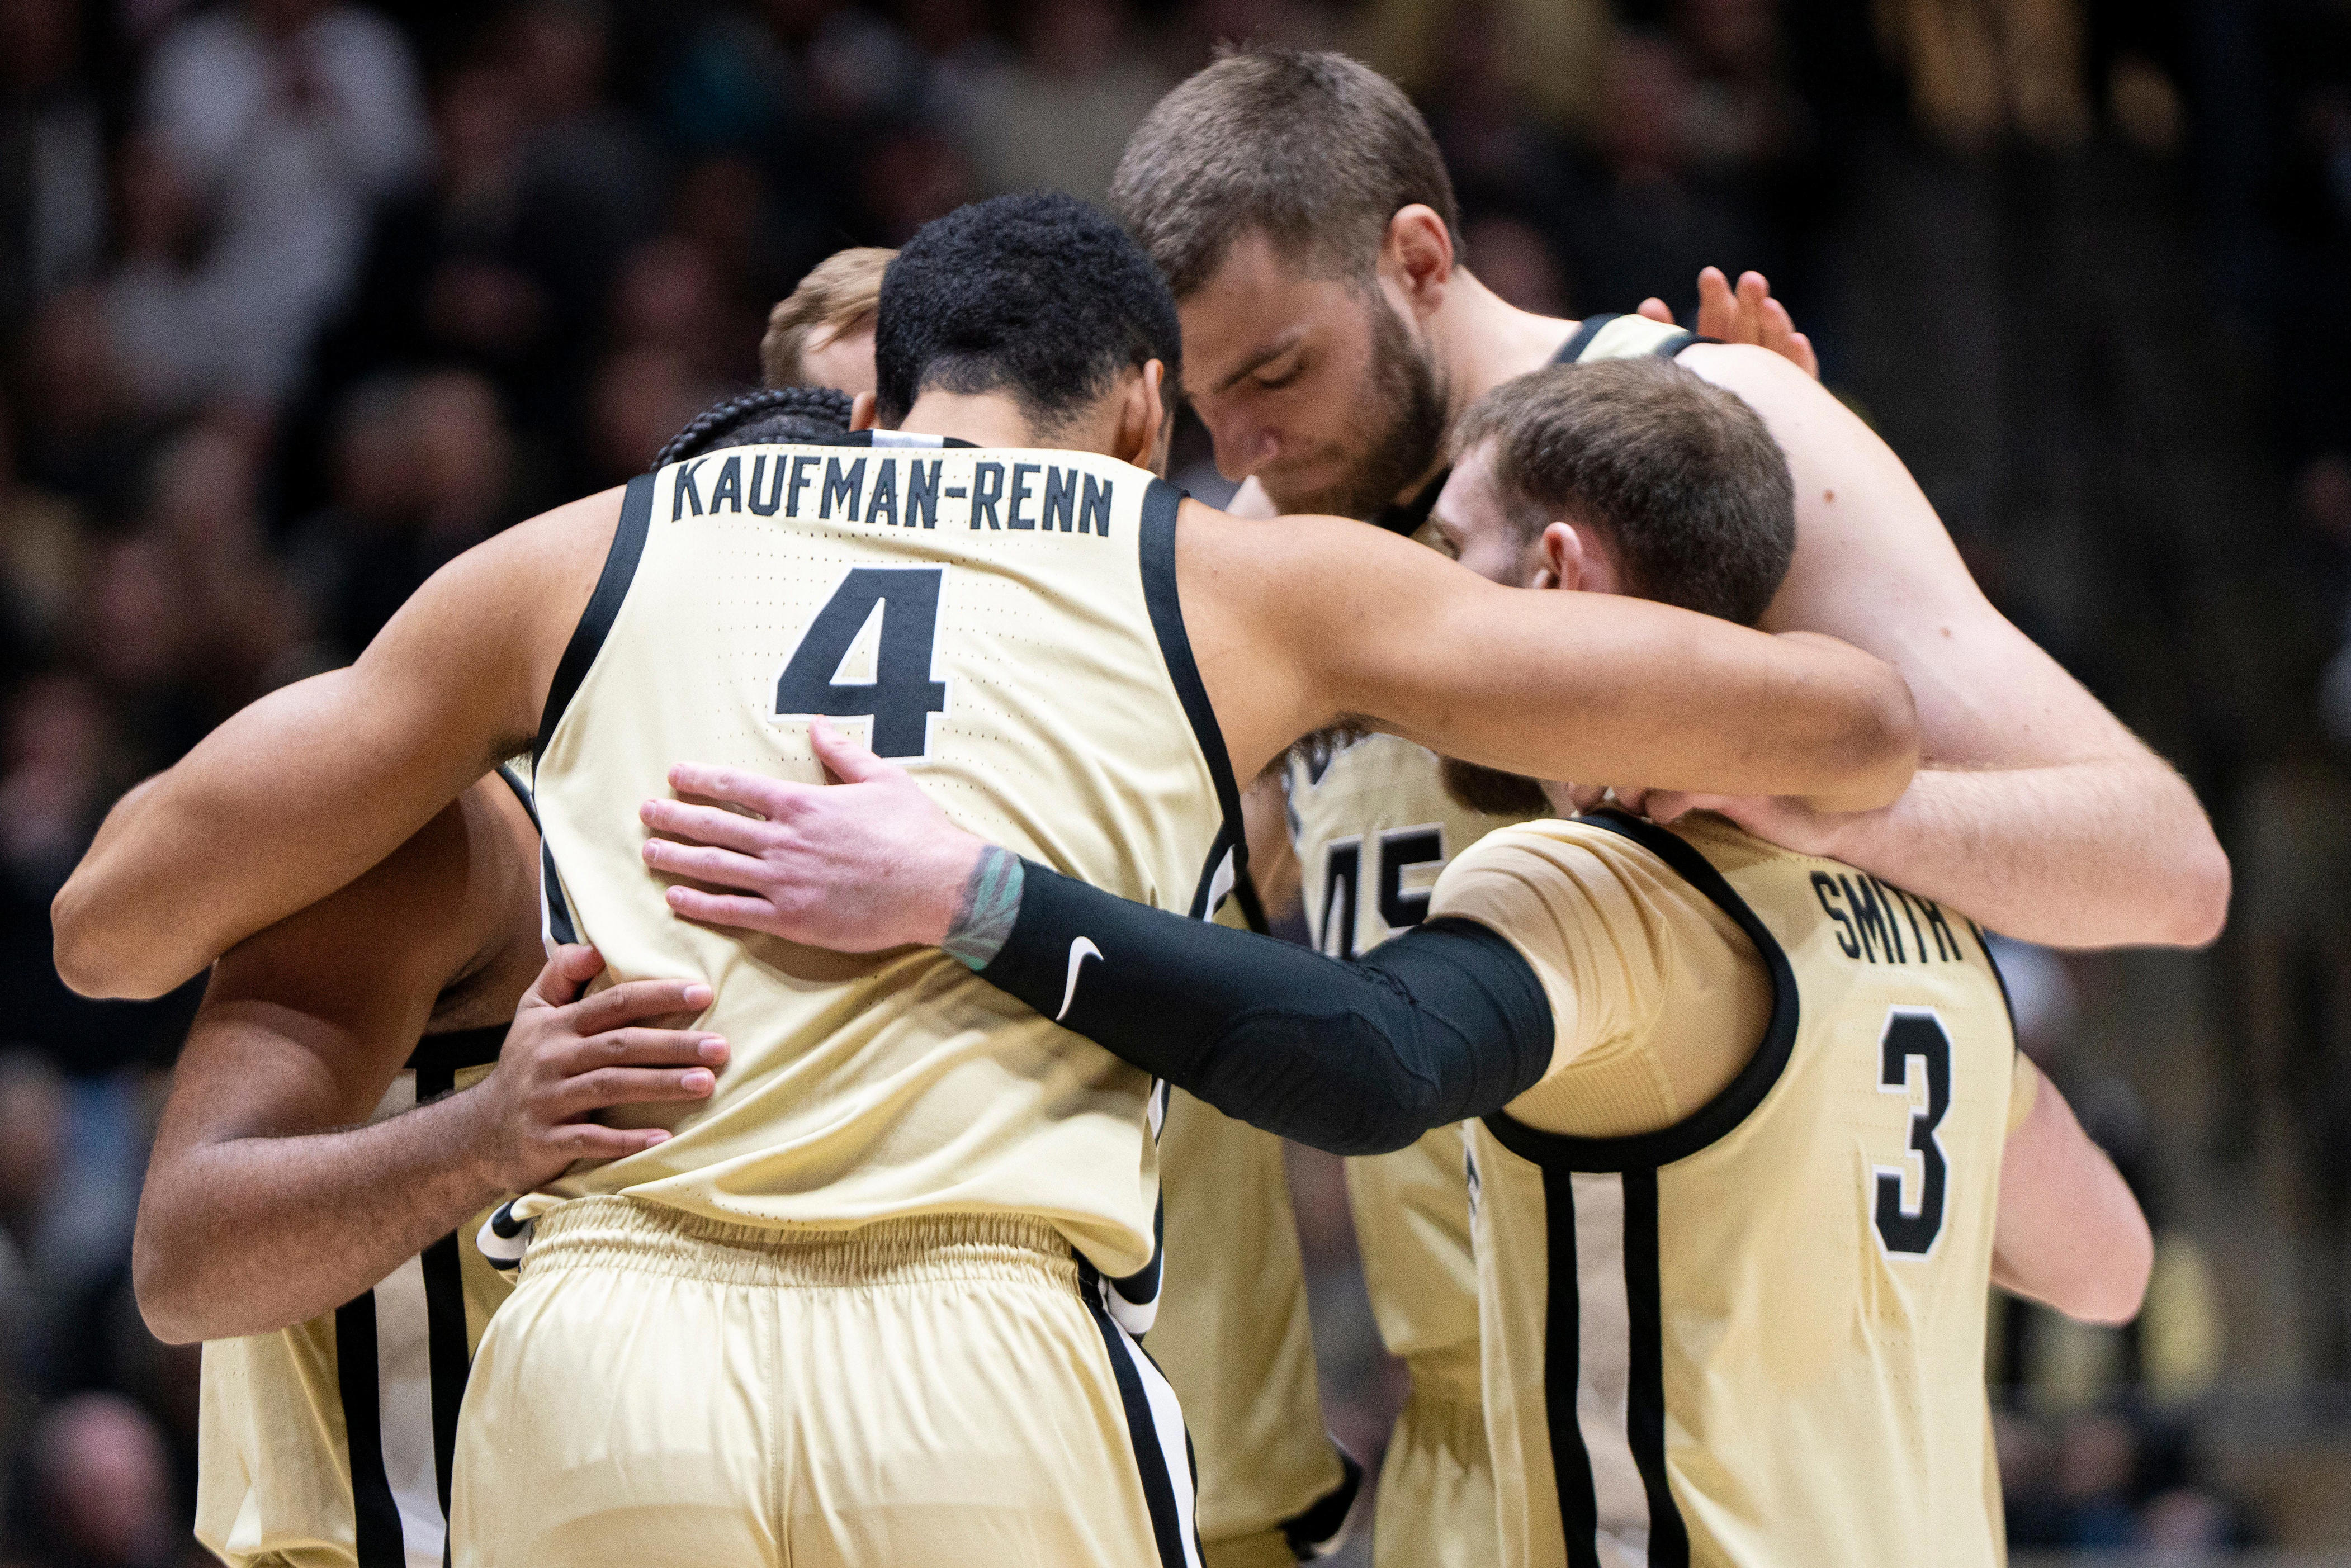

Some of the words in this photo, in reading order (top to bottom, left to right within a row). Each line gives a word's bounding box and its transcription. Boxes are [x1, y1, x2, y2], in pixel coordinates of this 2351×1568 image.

[671, 454, 1114, 538] KAUFMAN-RENN
[767, 562, 953, 764] 4
[1809, 870, 1963, 964] SMITH
[1869, 1005, 1952, 1261] 3
